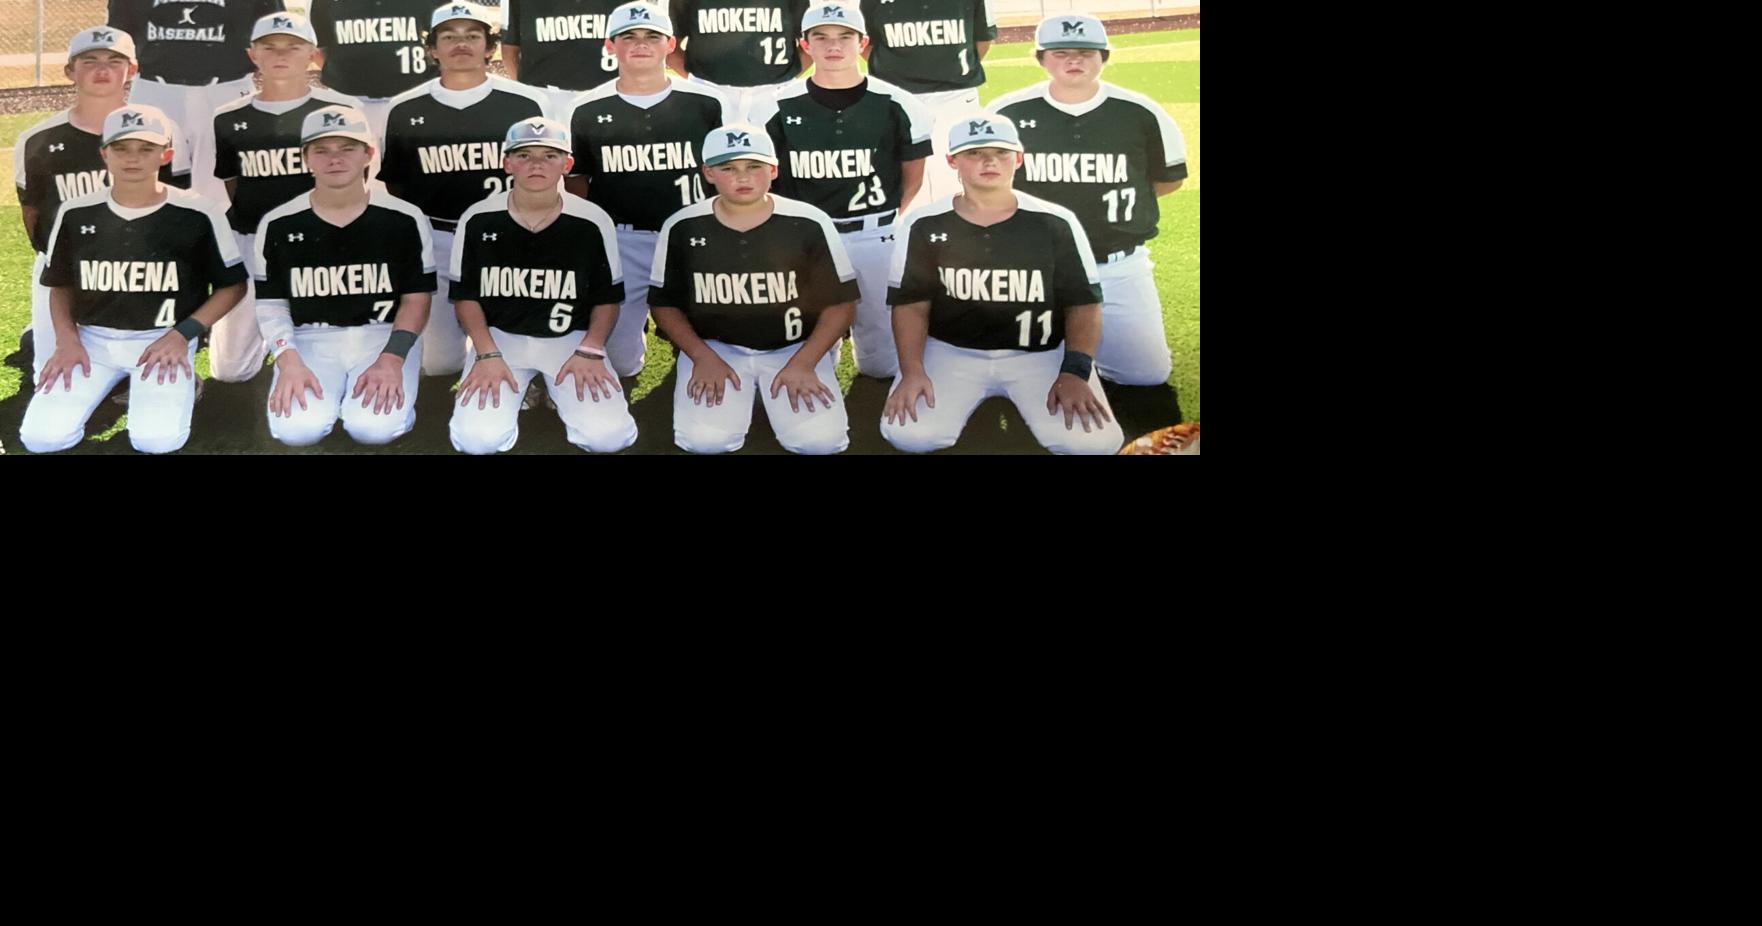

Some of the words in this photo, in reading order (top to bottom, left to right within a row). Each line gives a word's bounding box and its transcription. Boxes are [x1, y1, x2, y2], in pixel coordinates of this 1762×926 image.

[147, 21, 226, 42] BASEBALL
[335, 17, 418, 45] MOKENA
[698, 7, 783, 33] MOKENA
[396, 46, 426, 74] 18
[759, 36, 789, 65] 12
[958, 48, 970, 76] 1
[601, 141, 697, 173] MOKENA
[1024, 153, 1128, 183] MOKENA
[848, 176, 886, 211] 23
[1102, 187, 1136, 223] 17
[79, 260, 179, 292] MOKENA
[290, 263, 393, 298] MOKENA
[480, 266, 577, 300] MOKENA
[693, 270, 798, 305] MOKENA
[155, 299, 177, 327] 4
[372, 300, 394, 322] 7
[548, 303, 574, 333] 5
[784, 306, 803, 341] 6
[1015, 309, 1053, 347] 11
